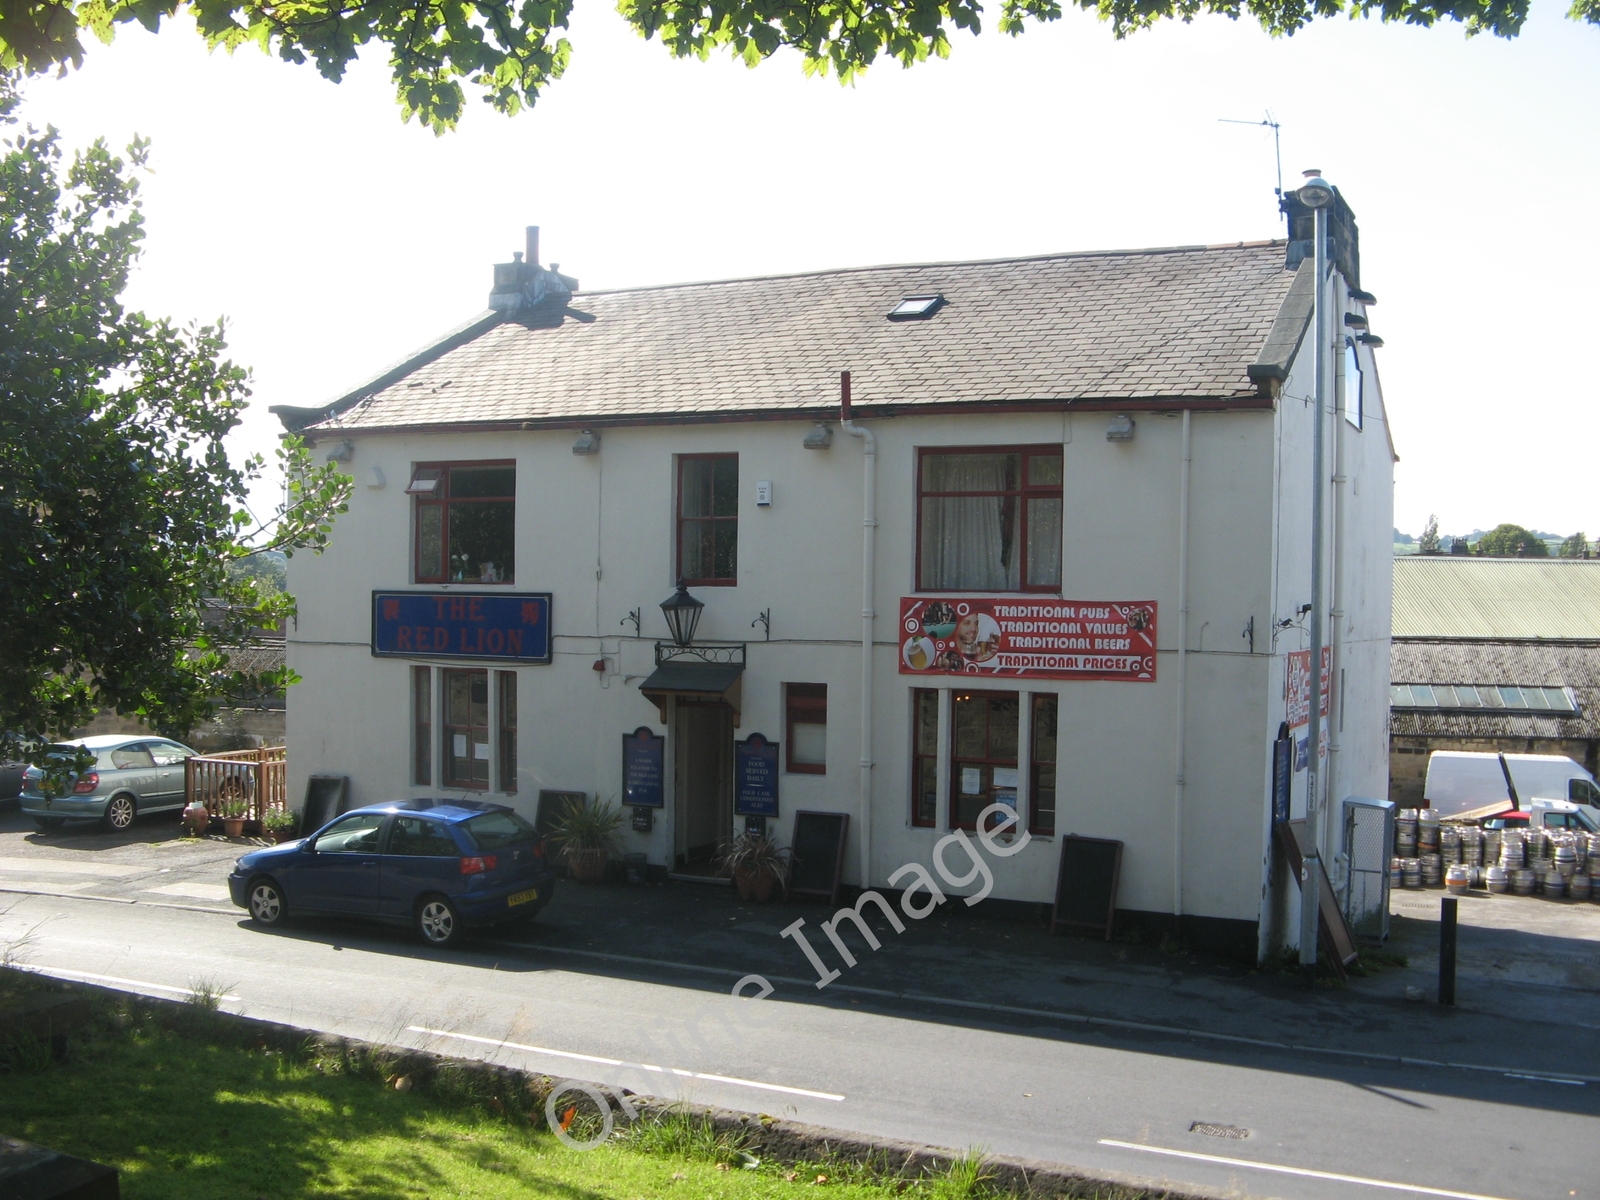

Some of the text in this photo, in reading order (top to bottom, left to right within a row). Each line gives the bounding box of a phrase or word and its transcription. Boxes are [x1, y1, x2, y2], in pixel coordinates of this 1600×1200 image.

[432, 596, 485, 621] THE
[994, 605, 1110, 619] TRADITIONAL PUBS
[1000, 620, 1128, 635] TRADITIONAL VALUES
[397, 626, 524, 654] RED LION
[1008, 636, 1131, 650] TRADITIONAL BEERS
[997, 655, 1128, 670] TRADITIONAL PRICES
[740, 795, 774, 803] CONDITIONED
